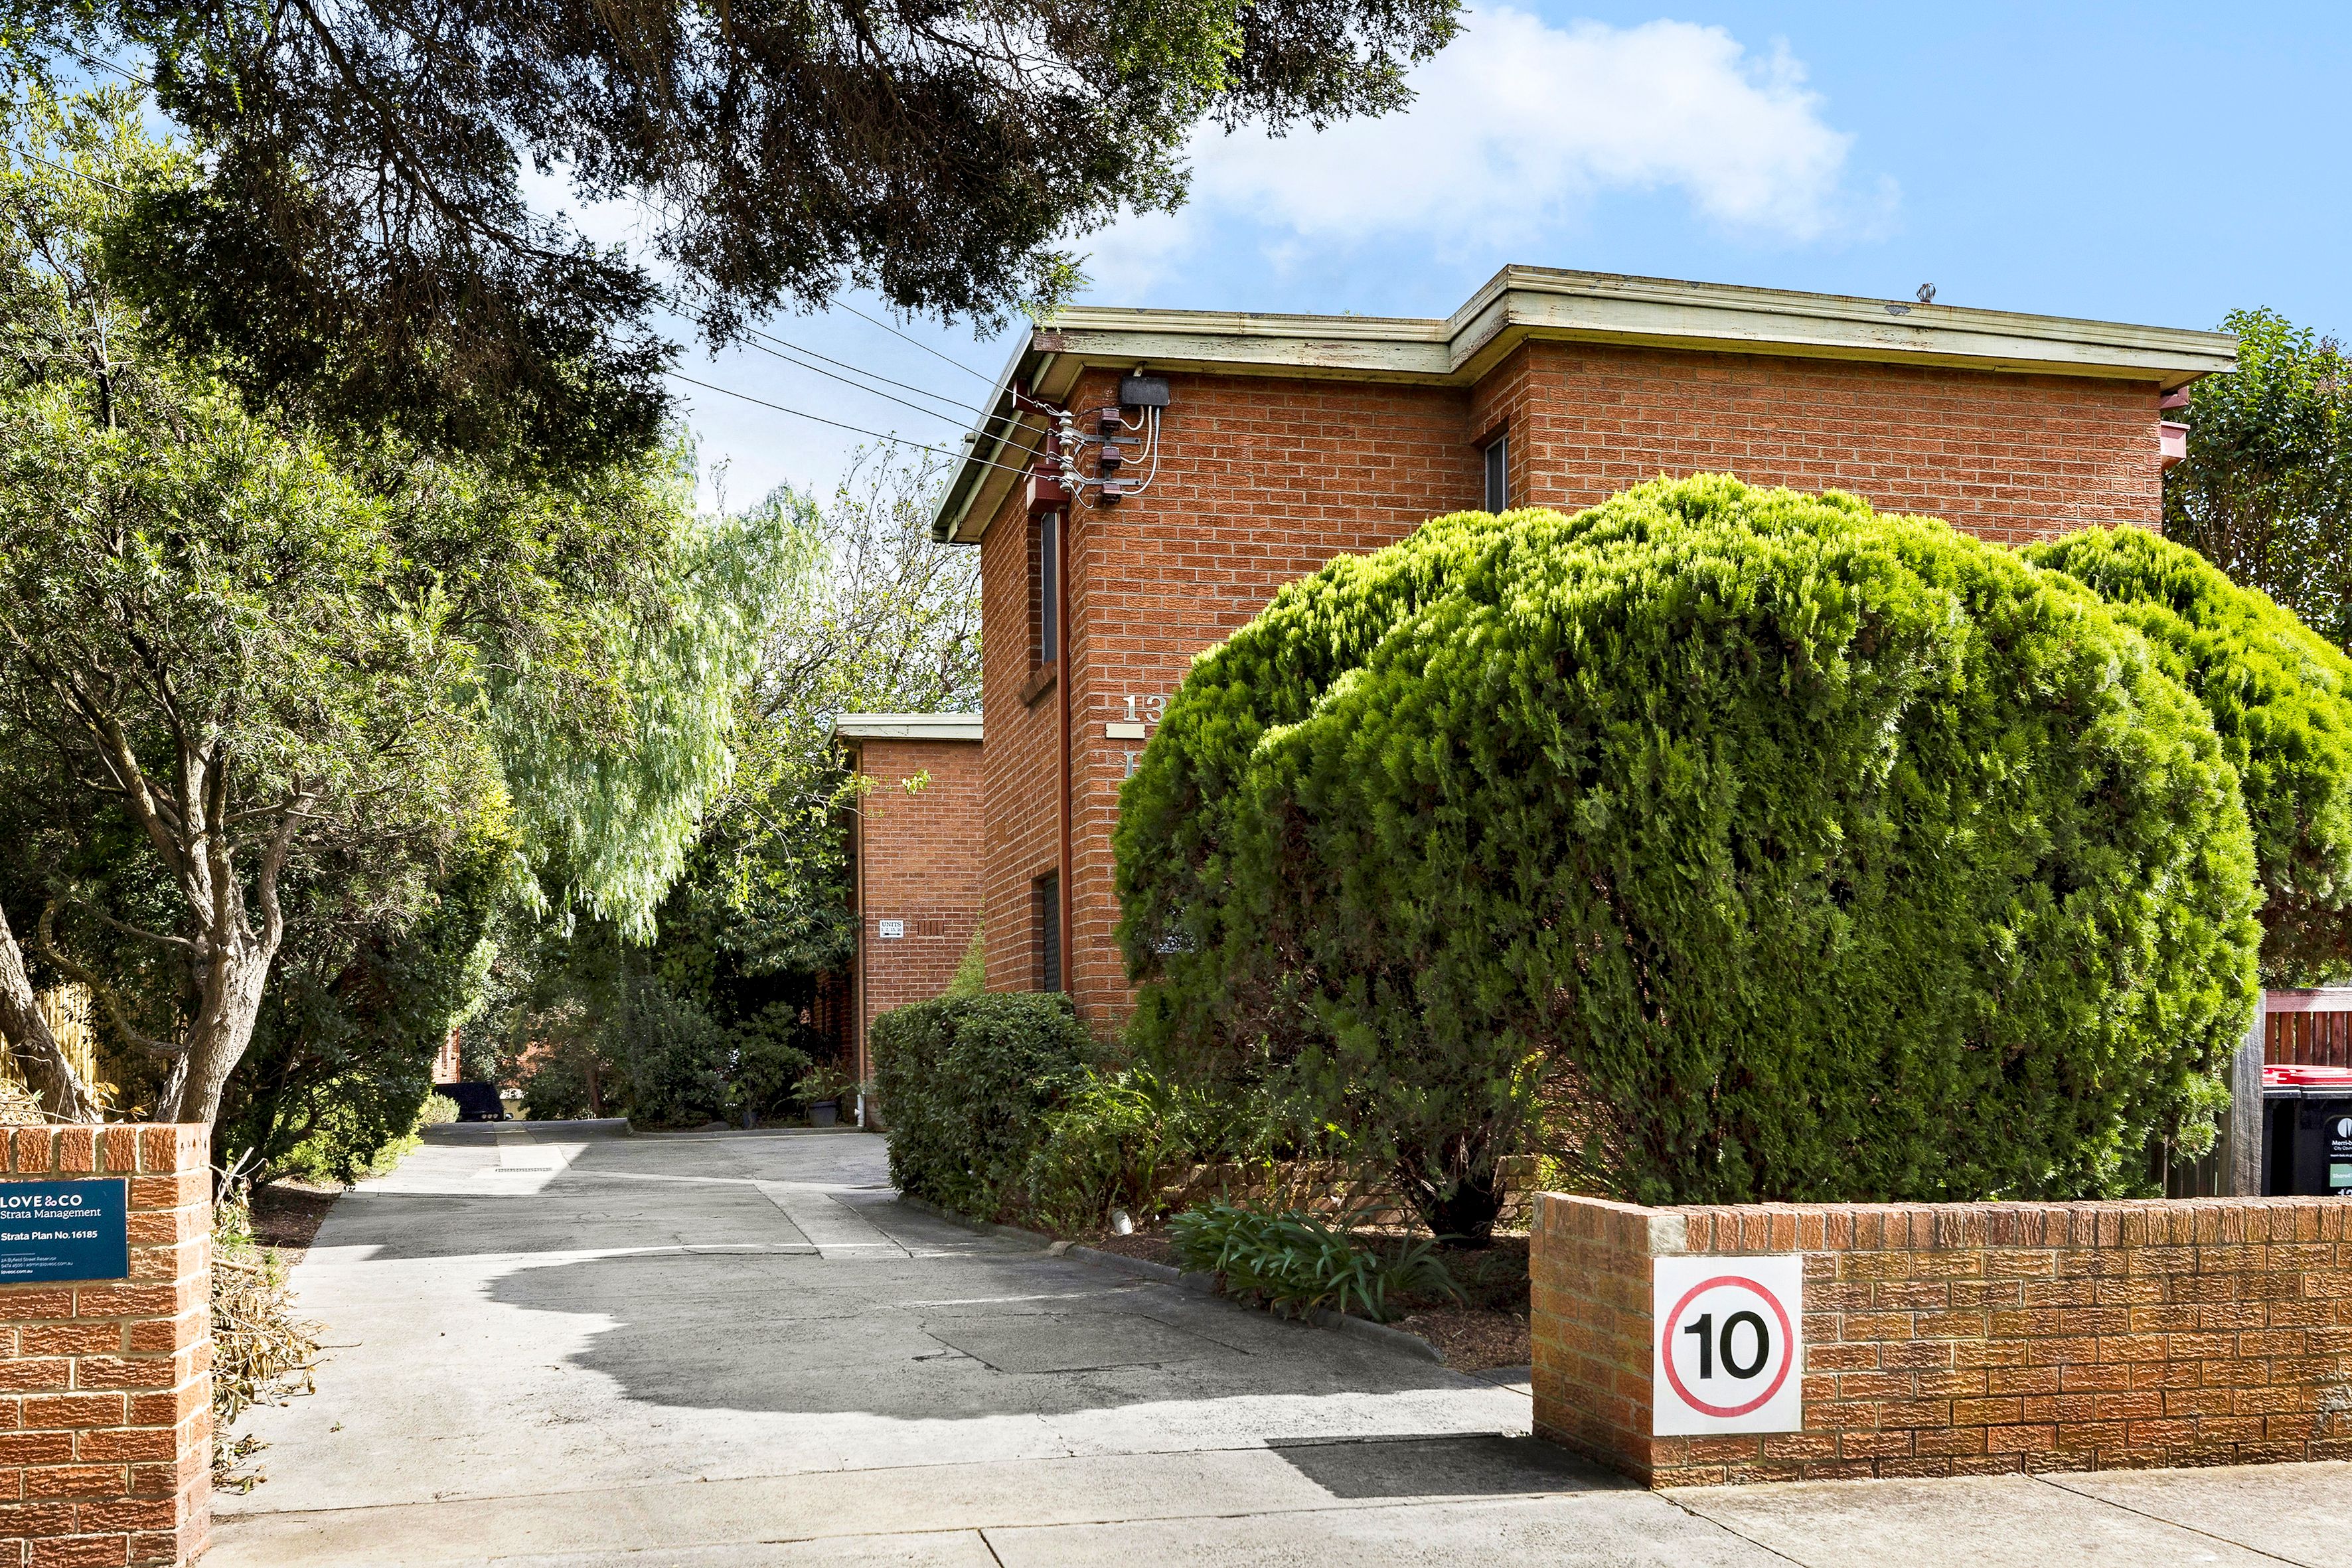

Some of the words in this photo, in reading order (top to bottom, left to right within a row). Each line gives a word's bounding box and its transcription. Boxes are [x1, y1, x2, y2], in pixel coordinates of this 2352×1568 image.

[1123, 694, 1166, 723] 13
[0, 1210, 32, 1219] Strata
[34, 1208, 102, 1219] Management
[1, 1232, 30, 1241] Strata
[31, 1231, 53, 1240] Plan
[1684, 1310, 1769, 1379] 10
